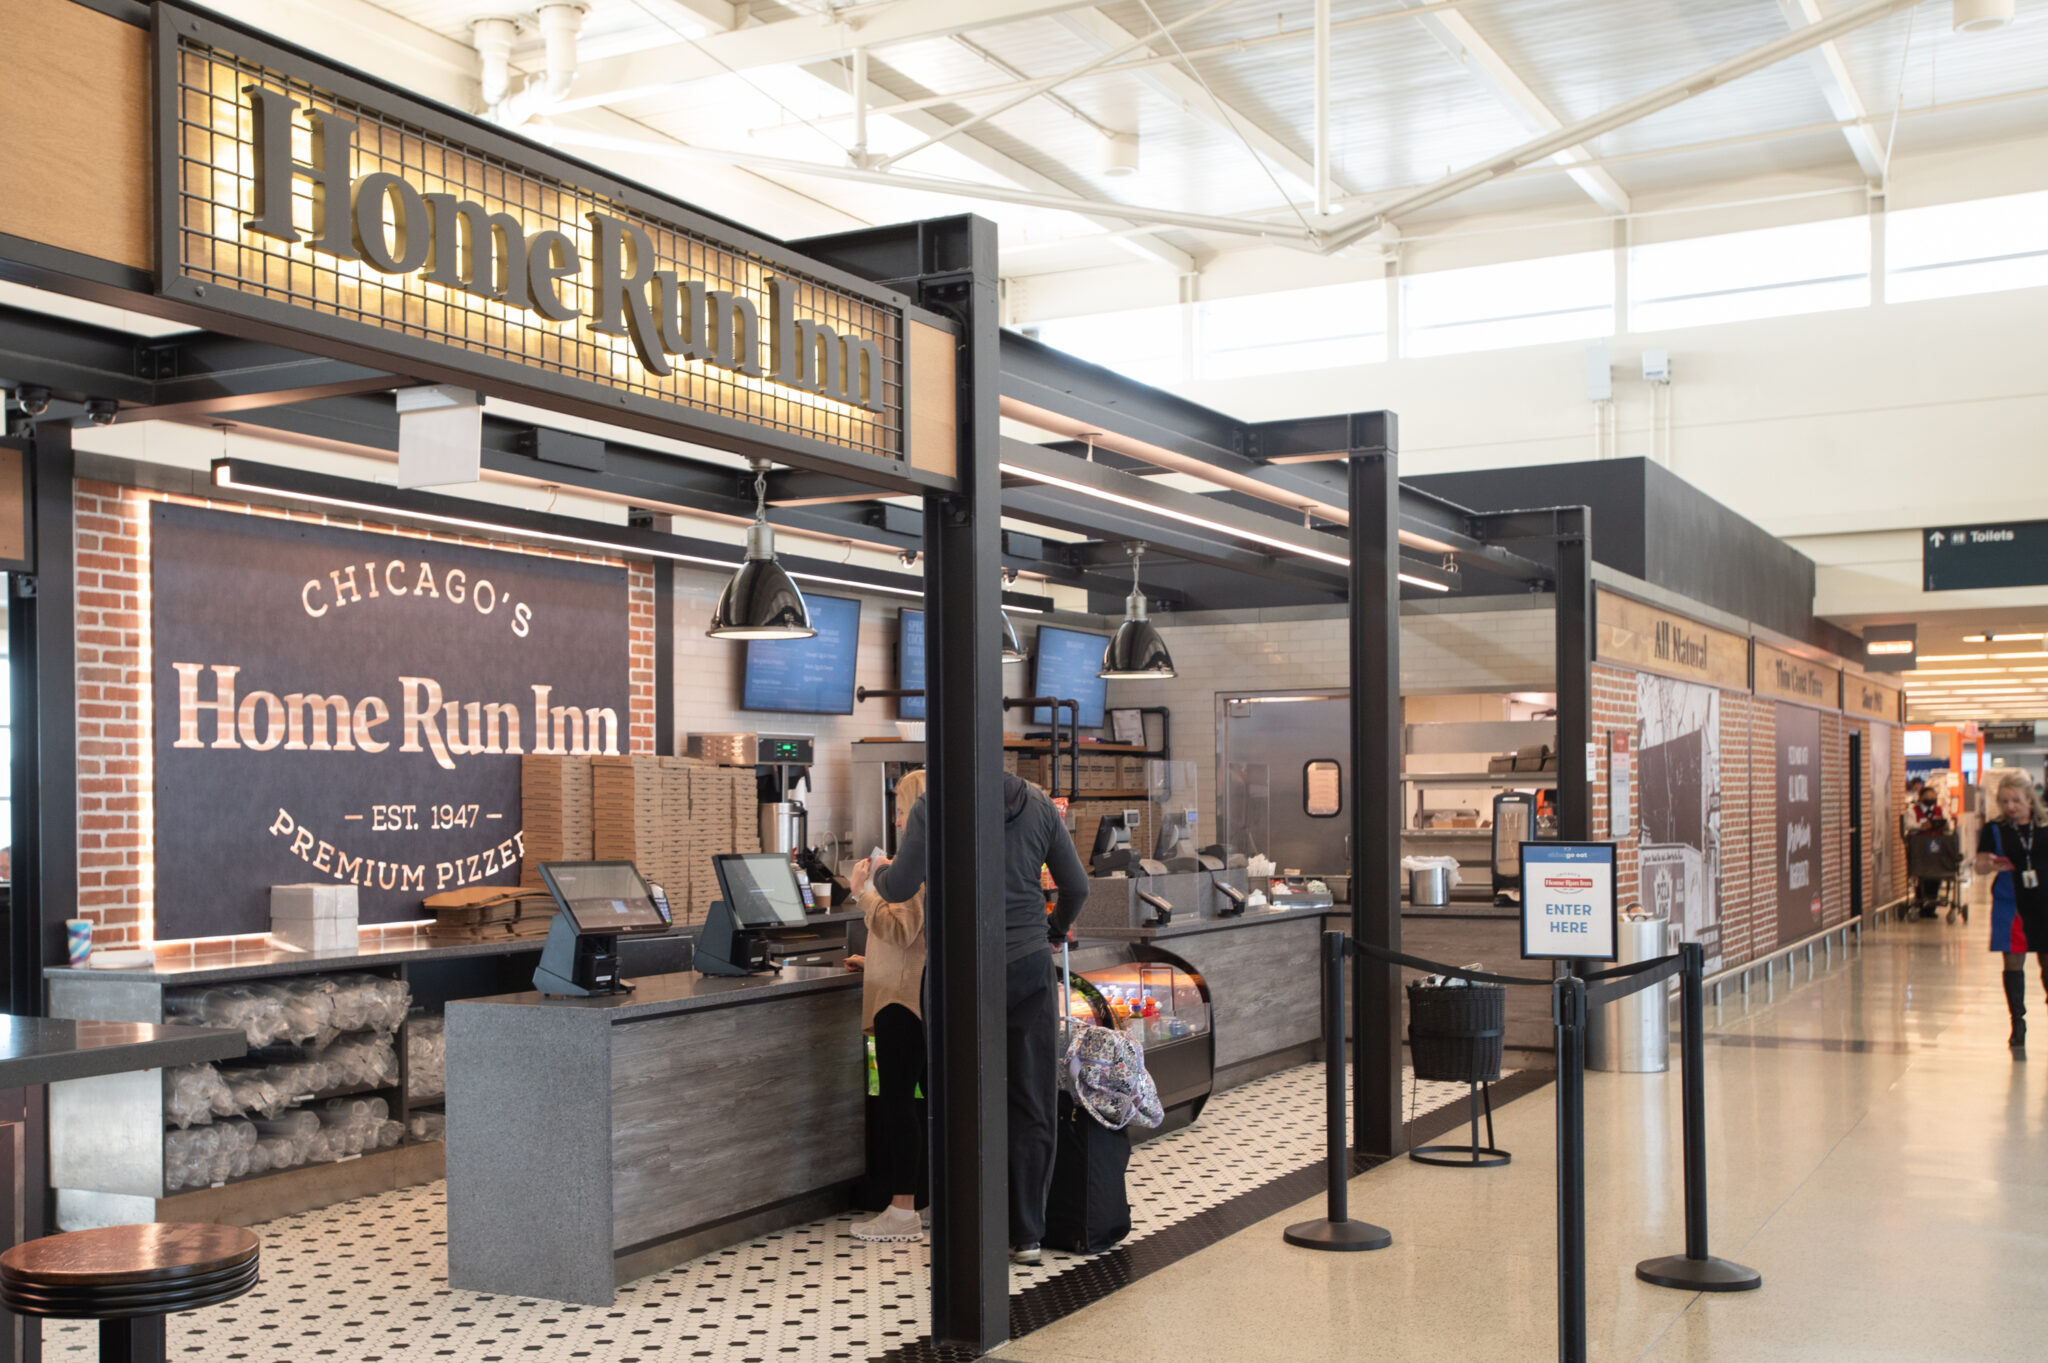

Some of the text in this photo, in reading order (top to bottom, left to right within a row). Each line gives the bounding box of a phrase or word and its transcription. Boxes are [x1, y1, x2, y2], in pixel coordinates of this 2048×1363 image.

[242, 84, 887, 413] Home Run Inn
[1970, 530, 2015, 543] Toilets
[301, 559, 532, 637] CHICAGO'S
[1654, 621, 1707, 670] All Natural
[172, 661, 621, 769] Home Run Inn
[372, 804, 480, 831] EST. 1947
[268, 808, 425, 892] PREMIUM
[1546, 904, 1592, 916] ENTER
[1550, 922, 1588, 933] HERE
